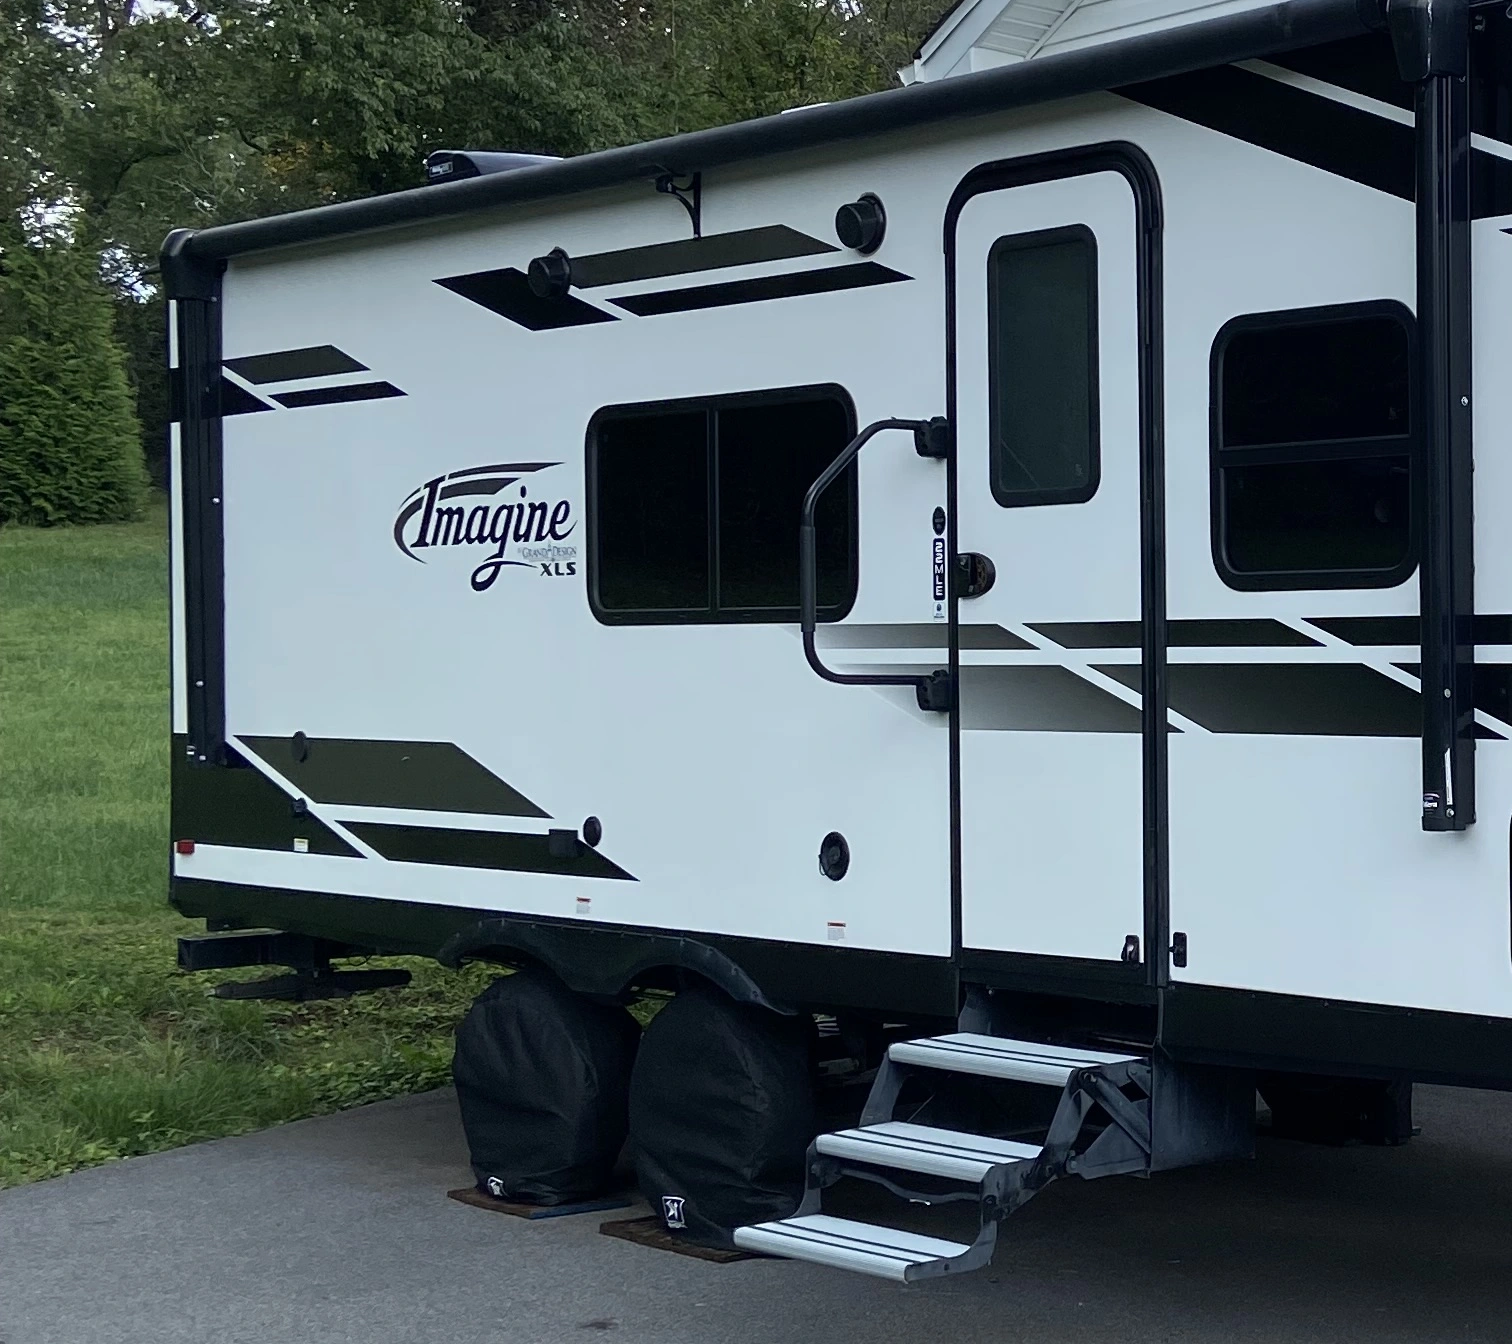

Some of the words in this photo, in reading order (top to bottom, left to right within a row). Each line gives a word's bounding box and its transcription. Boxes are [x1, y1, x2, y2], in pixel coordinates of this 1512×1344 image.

[410, 474, 578, 592] Imagine
[540, 561, 576, 577] XLS
[934, 541, 944, 596] 22MLE
